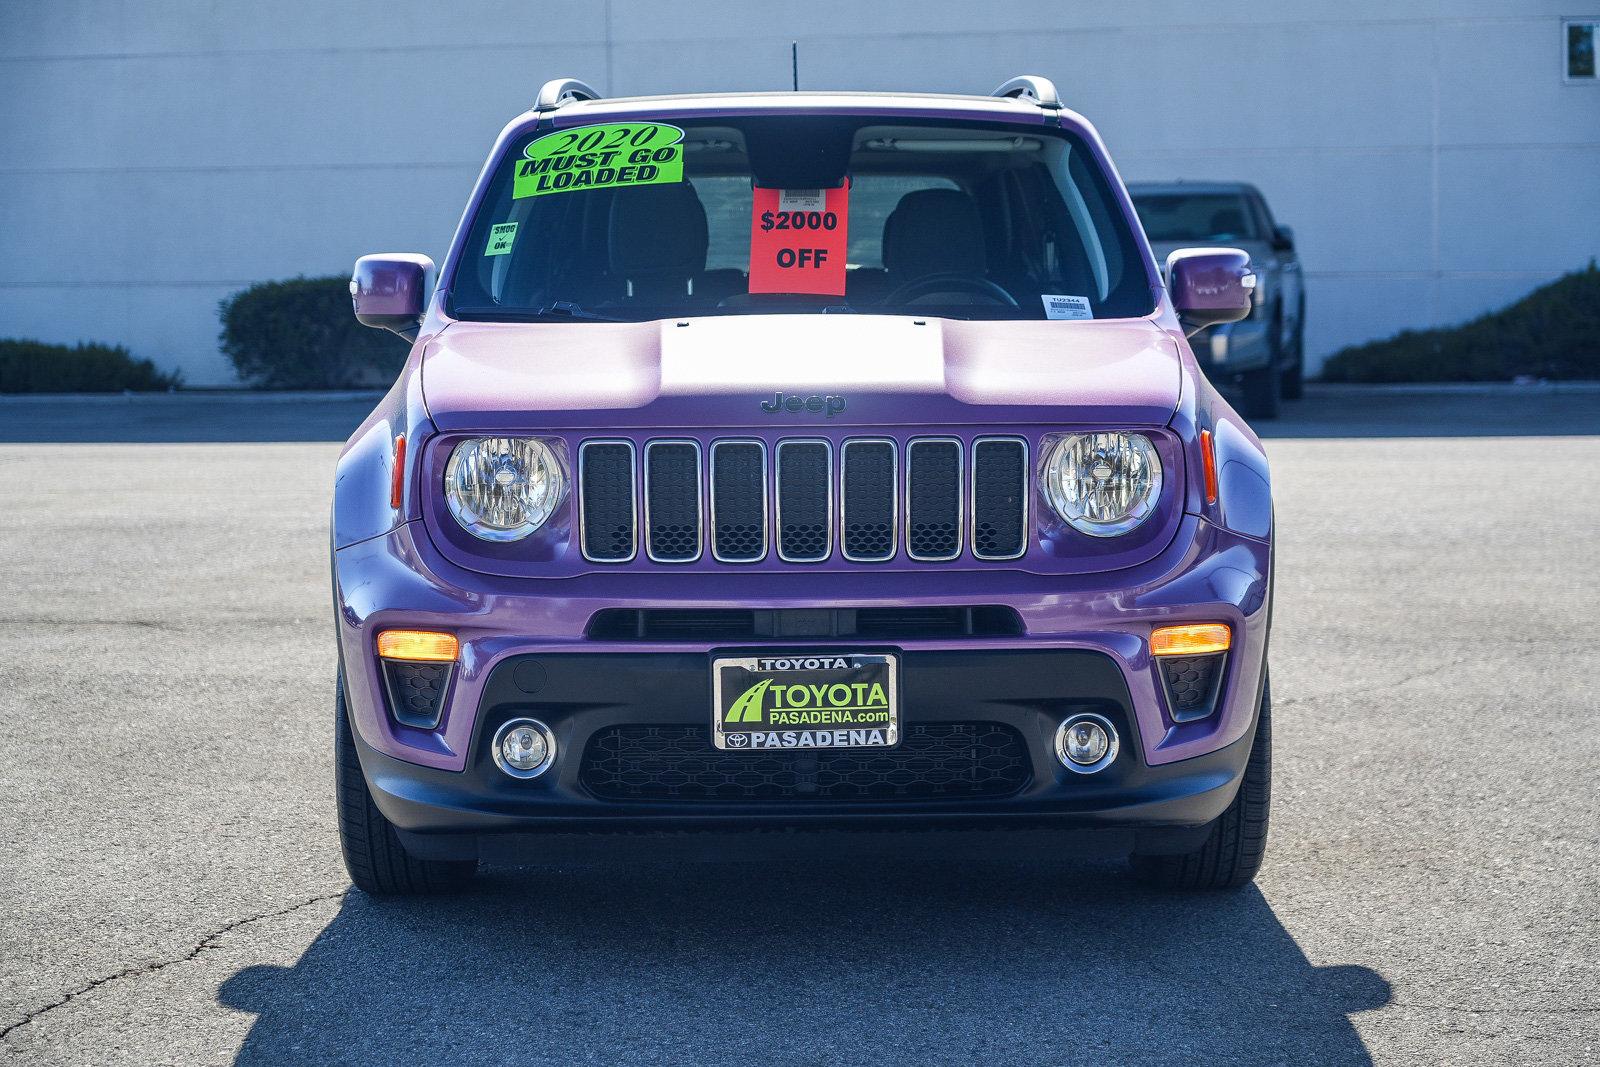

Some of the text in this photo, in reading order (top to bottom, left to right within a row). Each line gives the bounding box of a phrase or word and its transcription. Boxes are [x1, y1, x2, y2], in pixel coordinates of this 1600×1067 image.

[548, 126, 658, 156] 2020
[519, 147, 678, 177] MUST GO
[536, 165, 660, 192] LOADED
[761, 210, 838, 233] $2000
[494, 241, 507, 250] OK
[776, 248, 828, 269] OFF
[761, 391, 847, 418] Jeep
[761, 658, 848, 671] TOYOTA
[770, 683, 888, 708] TOYOTA
[770, 711, 889, 724] PASADENA.com
[751, 730, 884, 748] PASADENA
